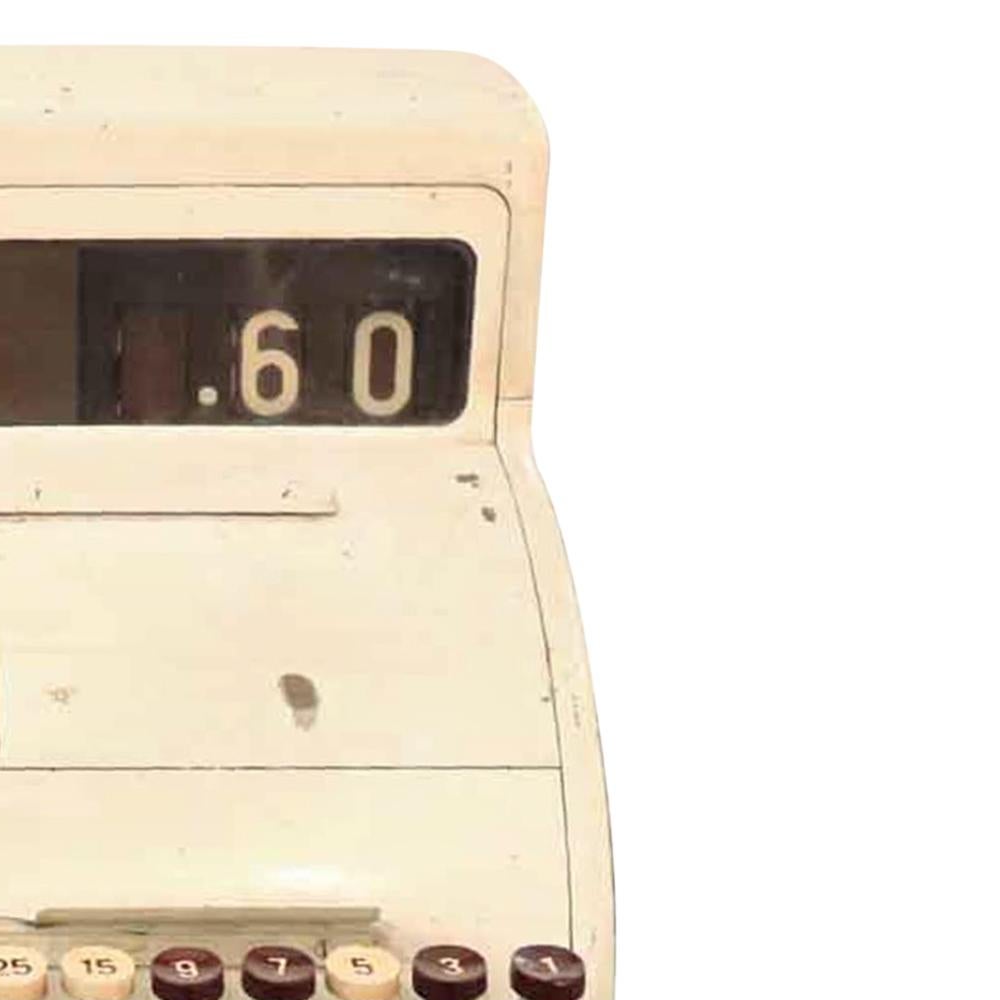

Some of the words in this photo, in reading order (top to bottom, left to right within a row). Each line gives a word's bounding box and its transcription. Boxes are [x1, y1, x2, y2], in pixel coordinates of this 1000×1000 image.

[81, 959, 117, 975] 15
[174, 959, 199, 978] 9
[267, 957, 286, 975] 7
[351, 959, 370, 973] 5
[440, 957, 462, 974] 3
[540, 957, 557, 973] 1
